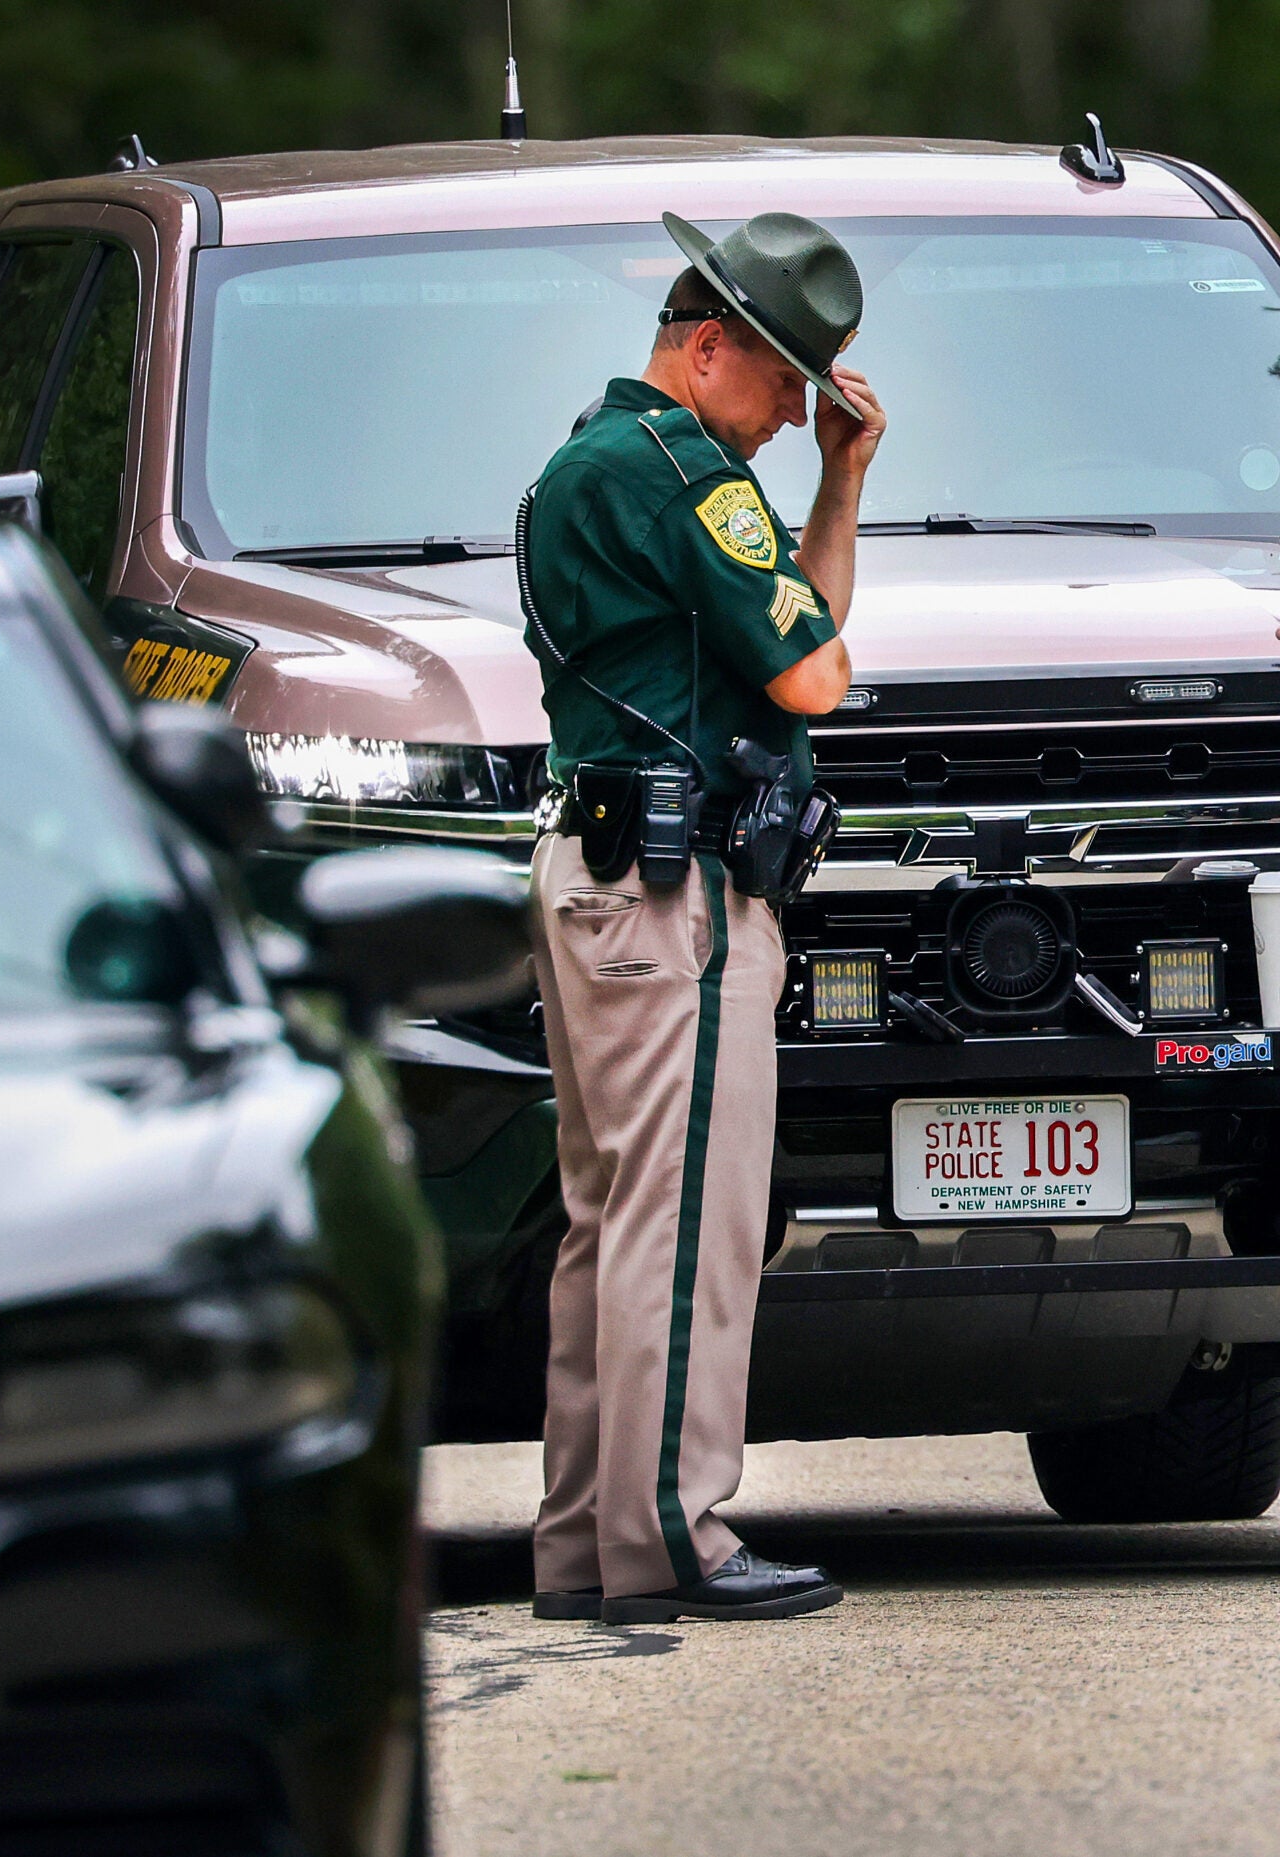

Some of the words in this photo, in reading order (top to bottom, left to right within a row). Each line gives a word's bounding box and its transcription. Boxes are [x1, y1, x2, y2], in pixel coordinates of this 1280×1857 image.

[705, 493, 727, 518] STATE
[724, 487, 752, 499] POLICE
[719, 526, 768, 559] DEPARTMENT
[148, 646, 231, 707] TROOPER
[1156, 1036, 1272, 1069] Pro-gard
[949, 1103, 980, 1116] LIVE
[984, 1102, 1020, 1115] FREE
[1024, 1102, 1045, 1114] OR
[1049, 1101, 1072, 1114] DIE
[925, 1121, 1003, 1150] STATE
[1023, 1119, 1100, 1178] 103
[925, 1151, 1004, 1180] POLICE
[931, 1185, 1013, 1198] DEPARTMENT
[1020, 1185, 1037, 1196] OF
[1044, 1184, 1093, 1195] SAFETY
[957, 1199, 986, 1211] NEW
[995, 1198, 1067, 1210] HAMPSHIRE
